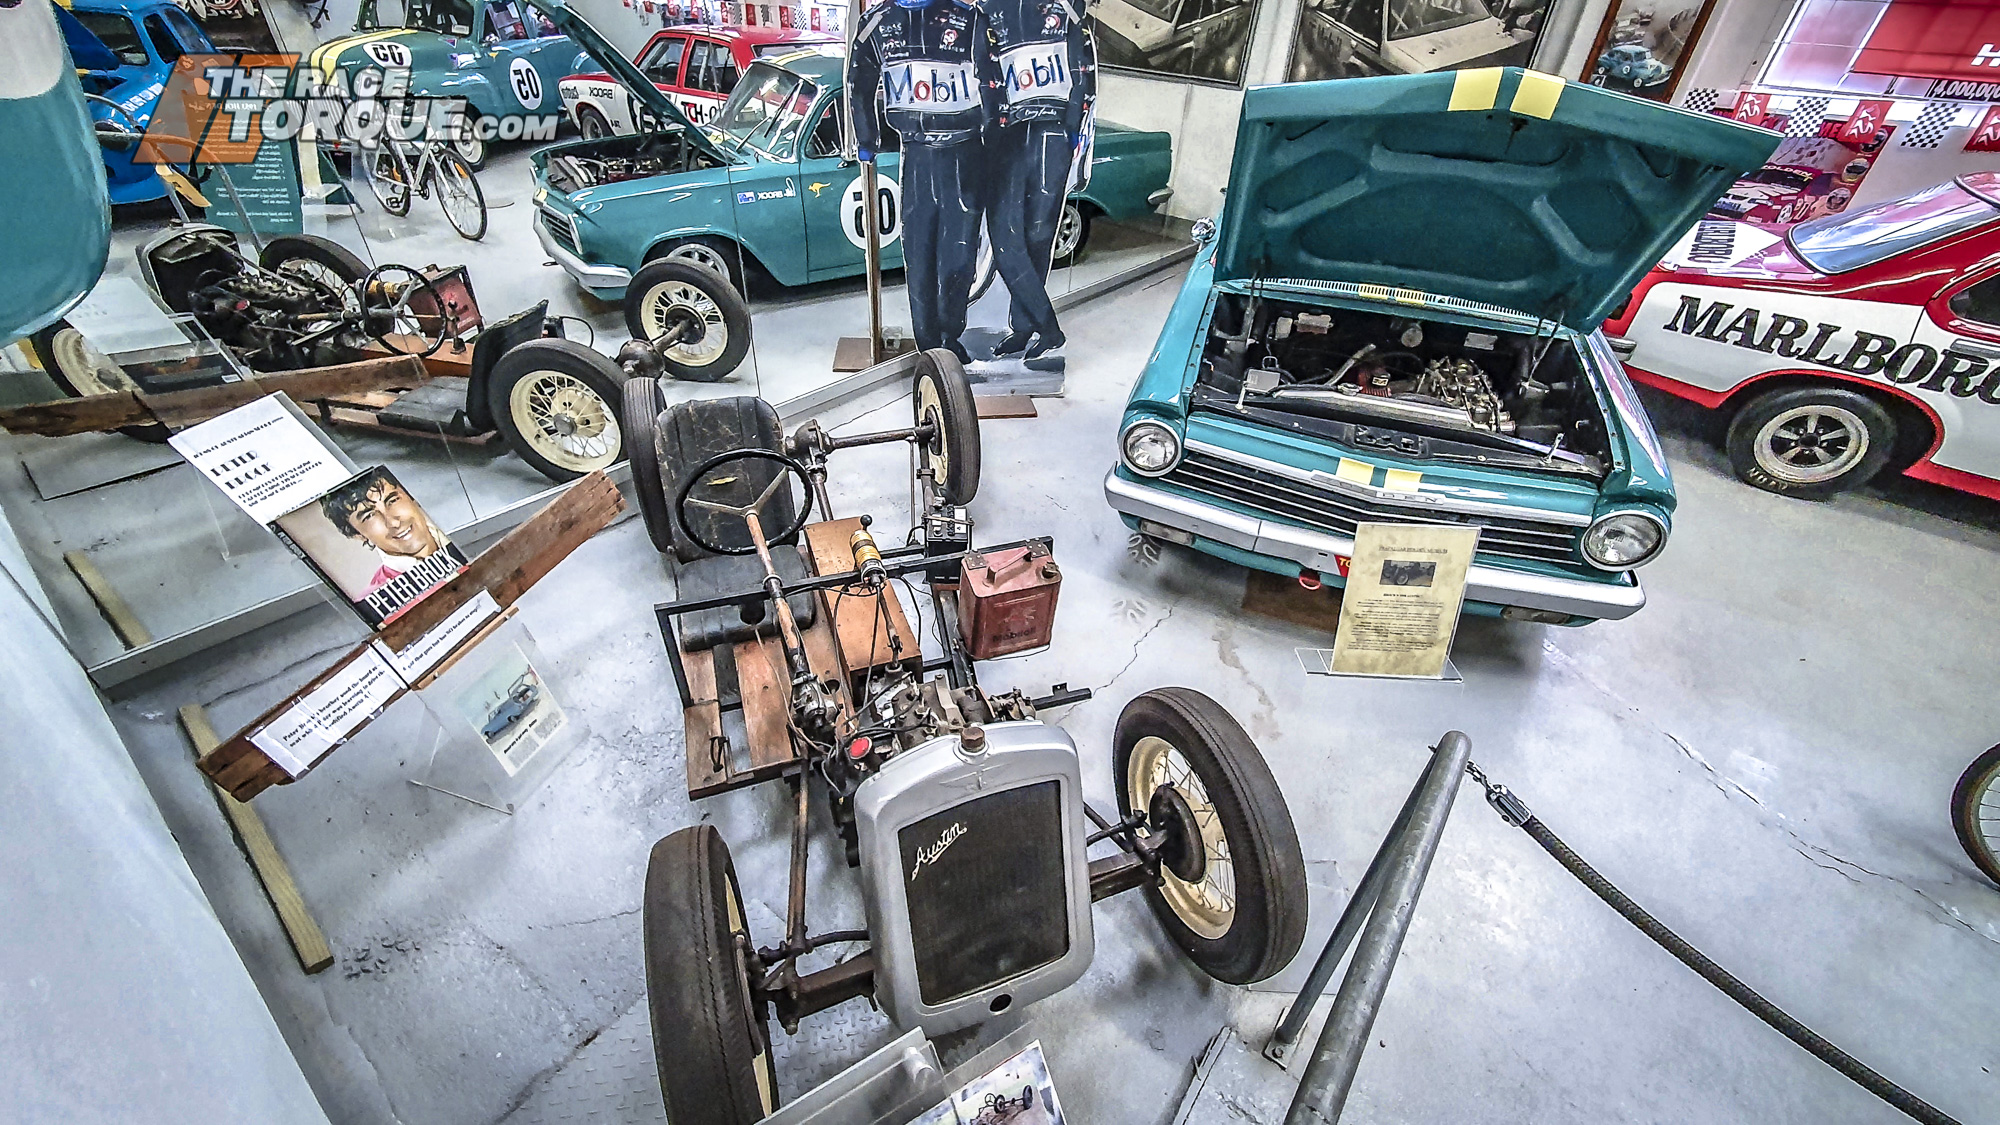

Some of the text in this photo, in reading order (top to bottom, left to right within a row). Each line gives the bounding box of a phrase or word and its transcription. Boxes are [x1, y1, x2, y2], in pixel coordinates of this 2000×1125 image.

[884, 64, 971, 104] Mobil
[364, 545, 464, 618] PETER BROCK
[281, 727, 300, 741] Peter
[911, 822, 968, 882] Austin
